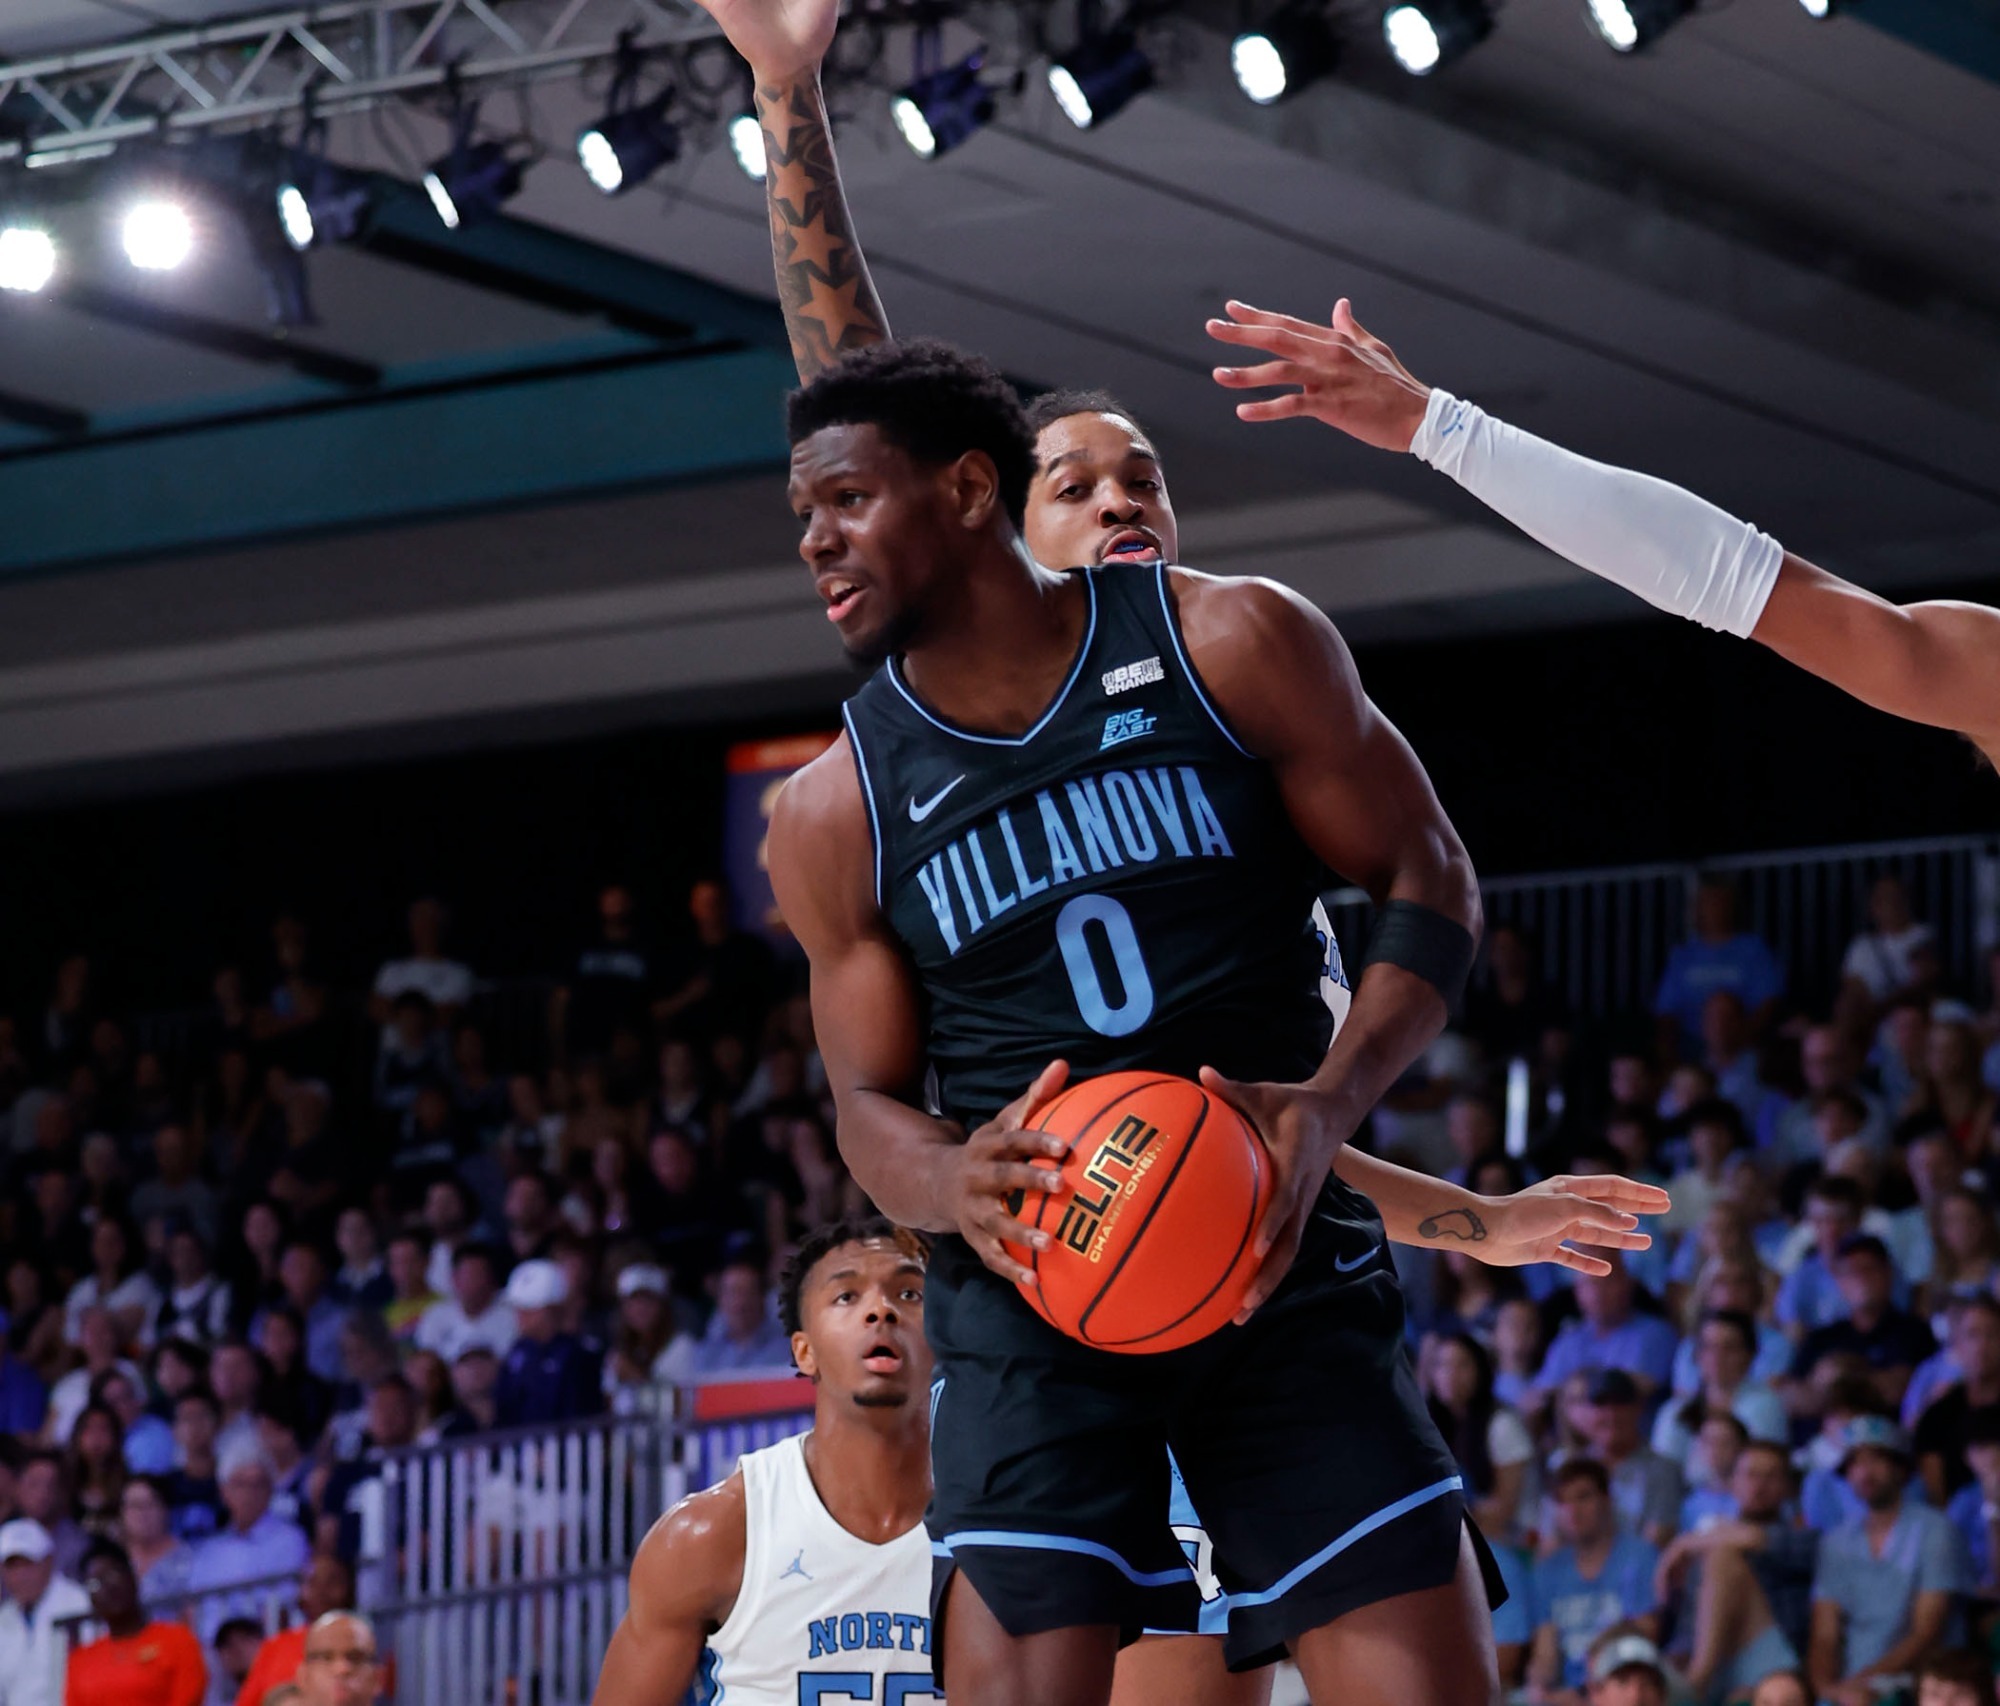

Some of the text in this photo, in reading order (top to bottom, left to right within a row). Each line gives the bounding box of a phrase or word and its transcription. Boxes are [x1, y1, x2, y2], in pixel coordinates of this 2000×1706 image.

[1104, 708, 1144, 731] BIG
[1105, 669, 1165, 696] CHANGE
[1102, 716, 1157, 743] EAST
[916, 766, 1236, 957] VILLANOVA
[1056, 894, 1155, 1038] 0
[1055, 1113, 1160, 1256] ELITE
